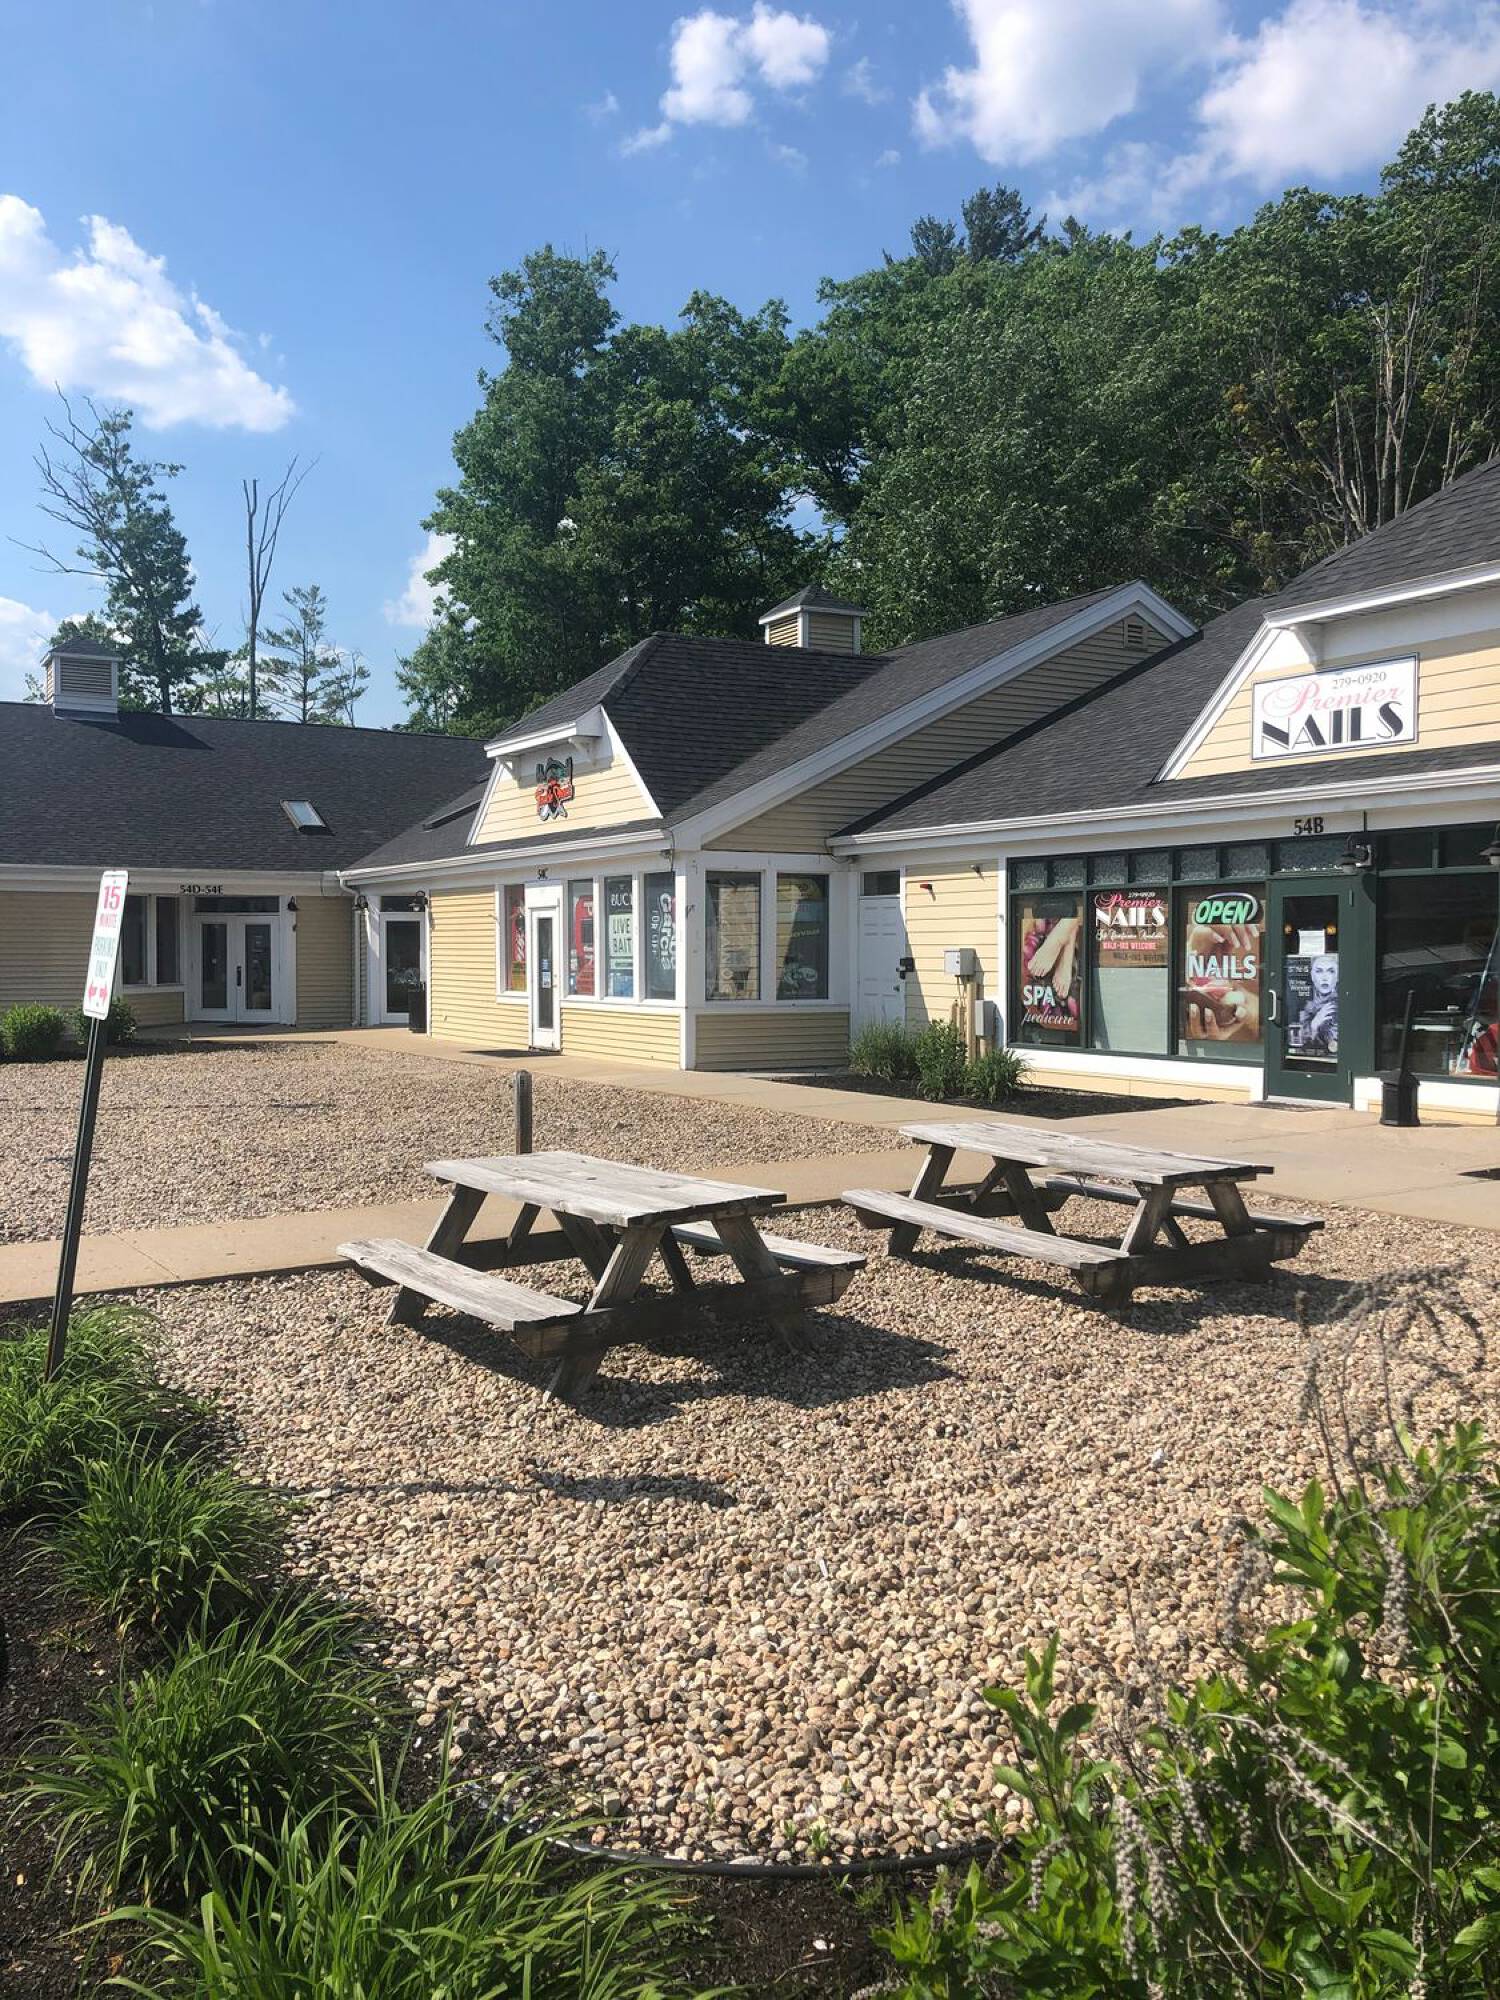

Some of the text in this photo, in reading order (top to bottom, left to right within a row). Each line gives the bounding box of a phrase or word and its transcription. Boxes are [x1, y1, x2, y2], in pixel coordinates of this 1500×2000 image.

[1262, 679, 1406, 718] Premier
[1261, 701, 1404, 753] NAILS
[1293, 816, 1325, 836] 54B
[103, 886, 121, 911] 15
[611, 892, 633, 907] BUC
[1094, 892, 1165, 910] Premier
[1095, 906, 1166, 928] NAILS
[1196, 900, 1250, 924] OPEN
[613, 918, 631, 934] LIVE
[612, 938, 633, 953] BAIT
[1188, 955, 1258, 980] NAILS
[1023, 985, 1057, 1007] SPA
